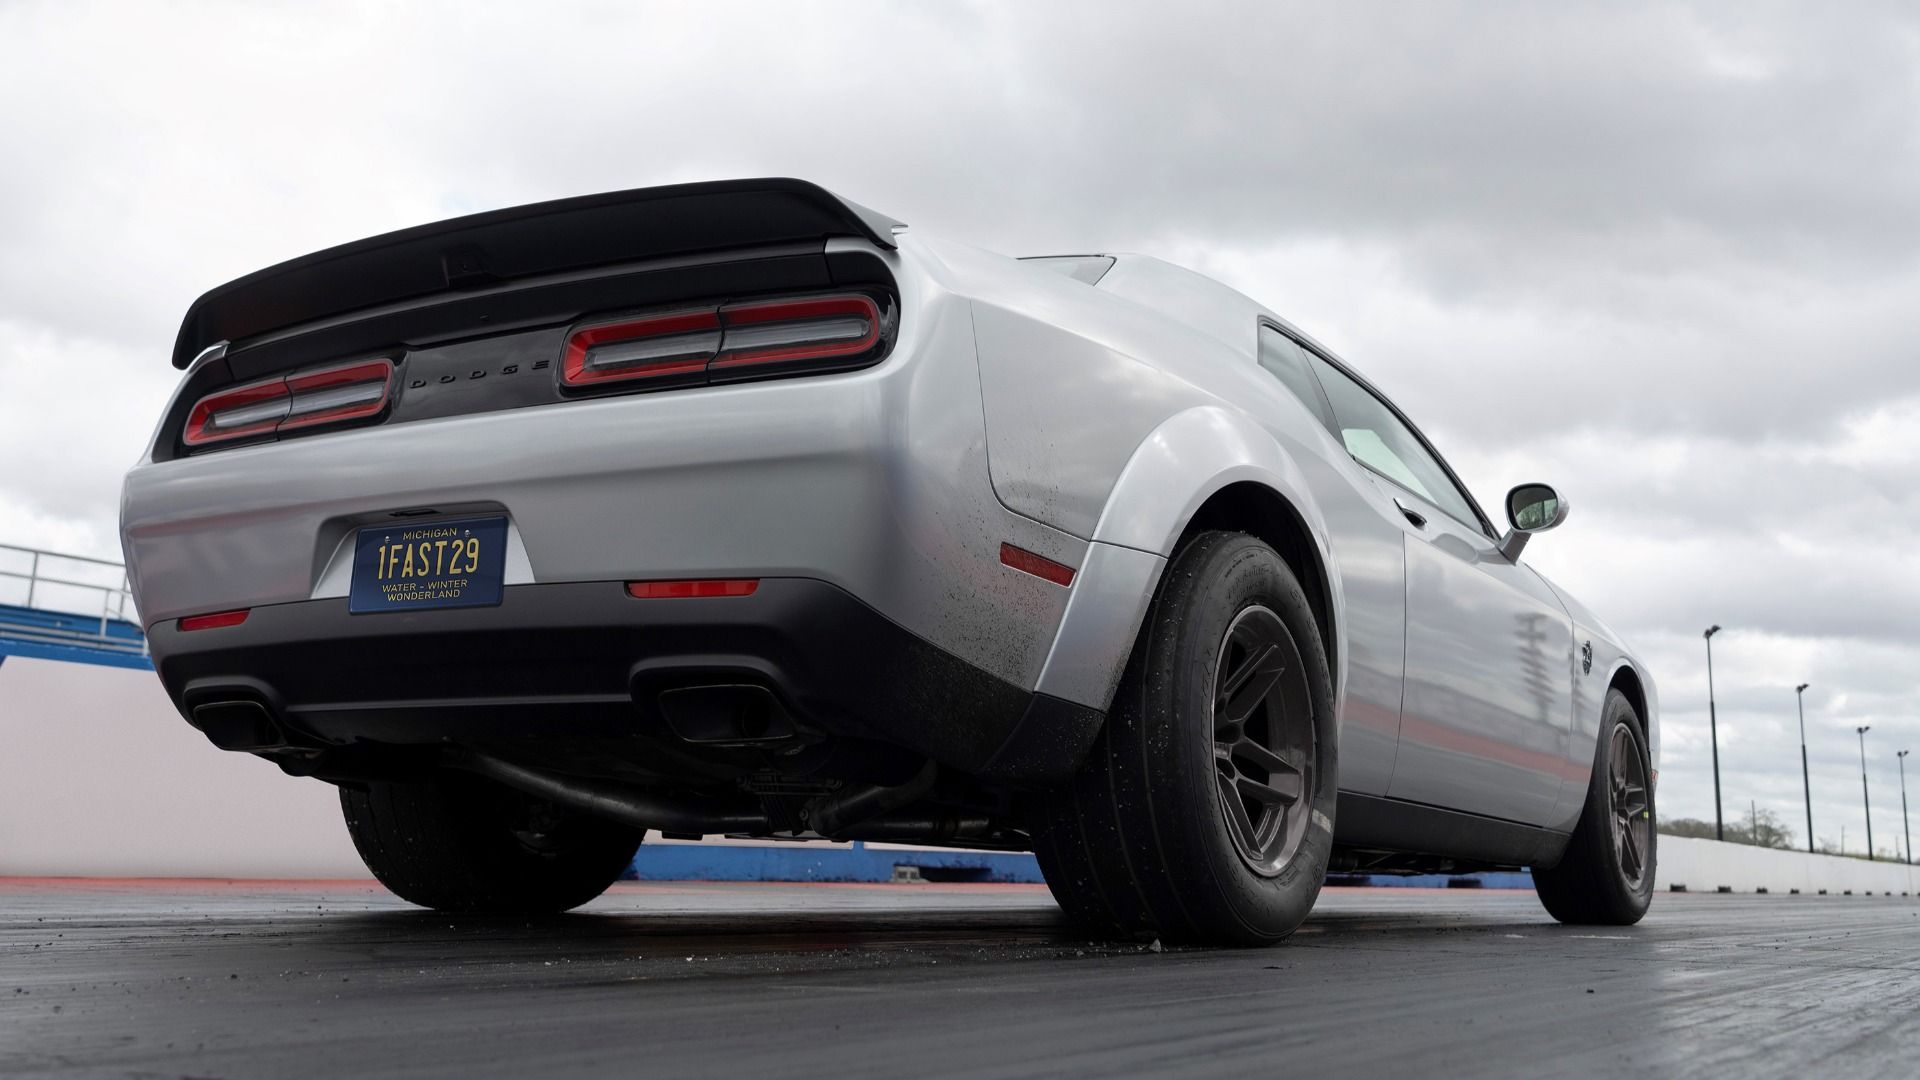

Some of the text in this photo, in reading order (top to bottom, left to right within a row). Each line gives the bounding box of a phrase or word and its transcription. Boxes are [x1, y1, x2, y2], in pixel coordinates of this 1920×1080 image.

[410, 360, 550, 389] DODGE
[402, 528, 457, 540] MICHIGAN
[378, 538, 480, 580] 1FAST29
[382, 583, 416, 593] WATER
[428, 579, 468, 590] WINTER
[387, 589, 460, 602] WONDERLAND
